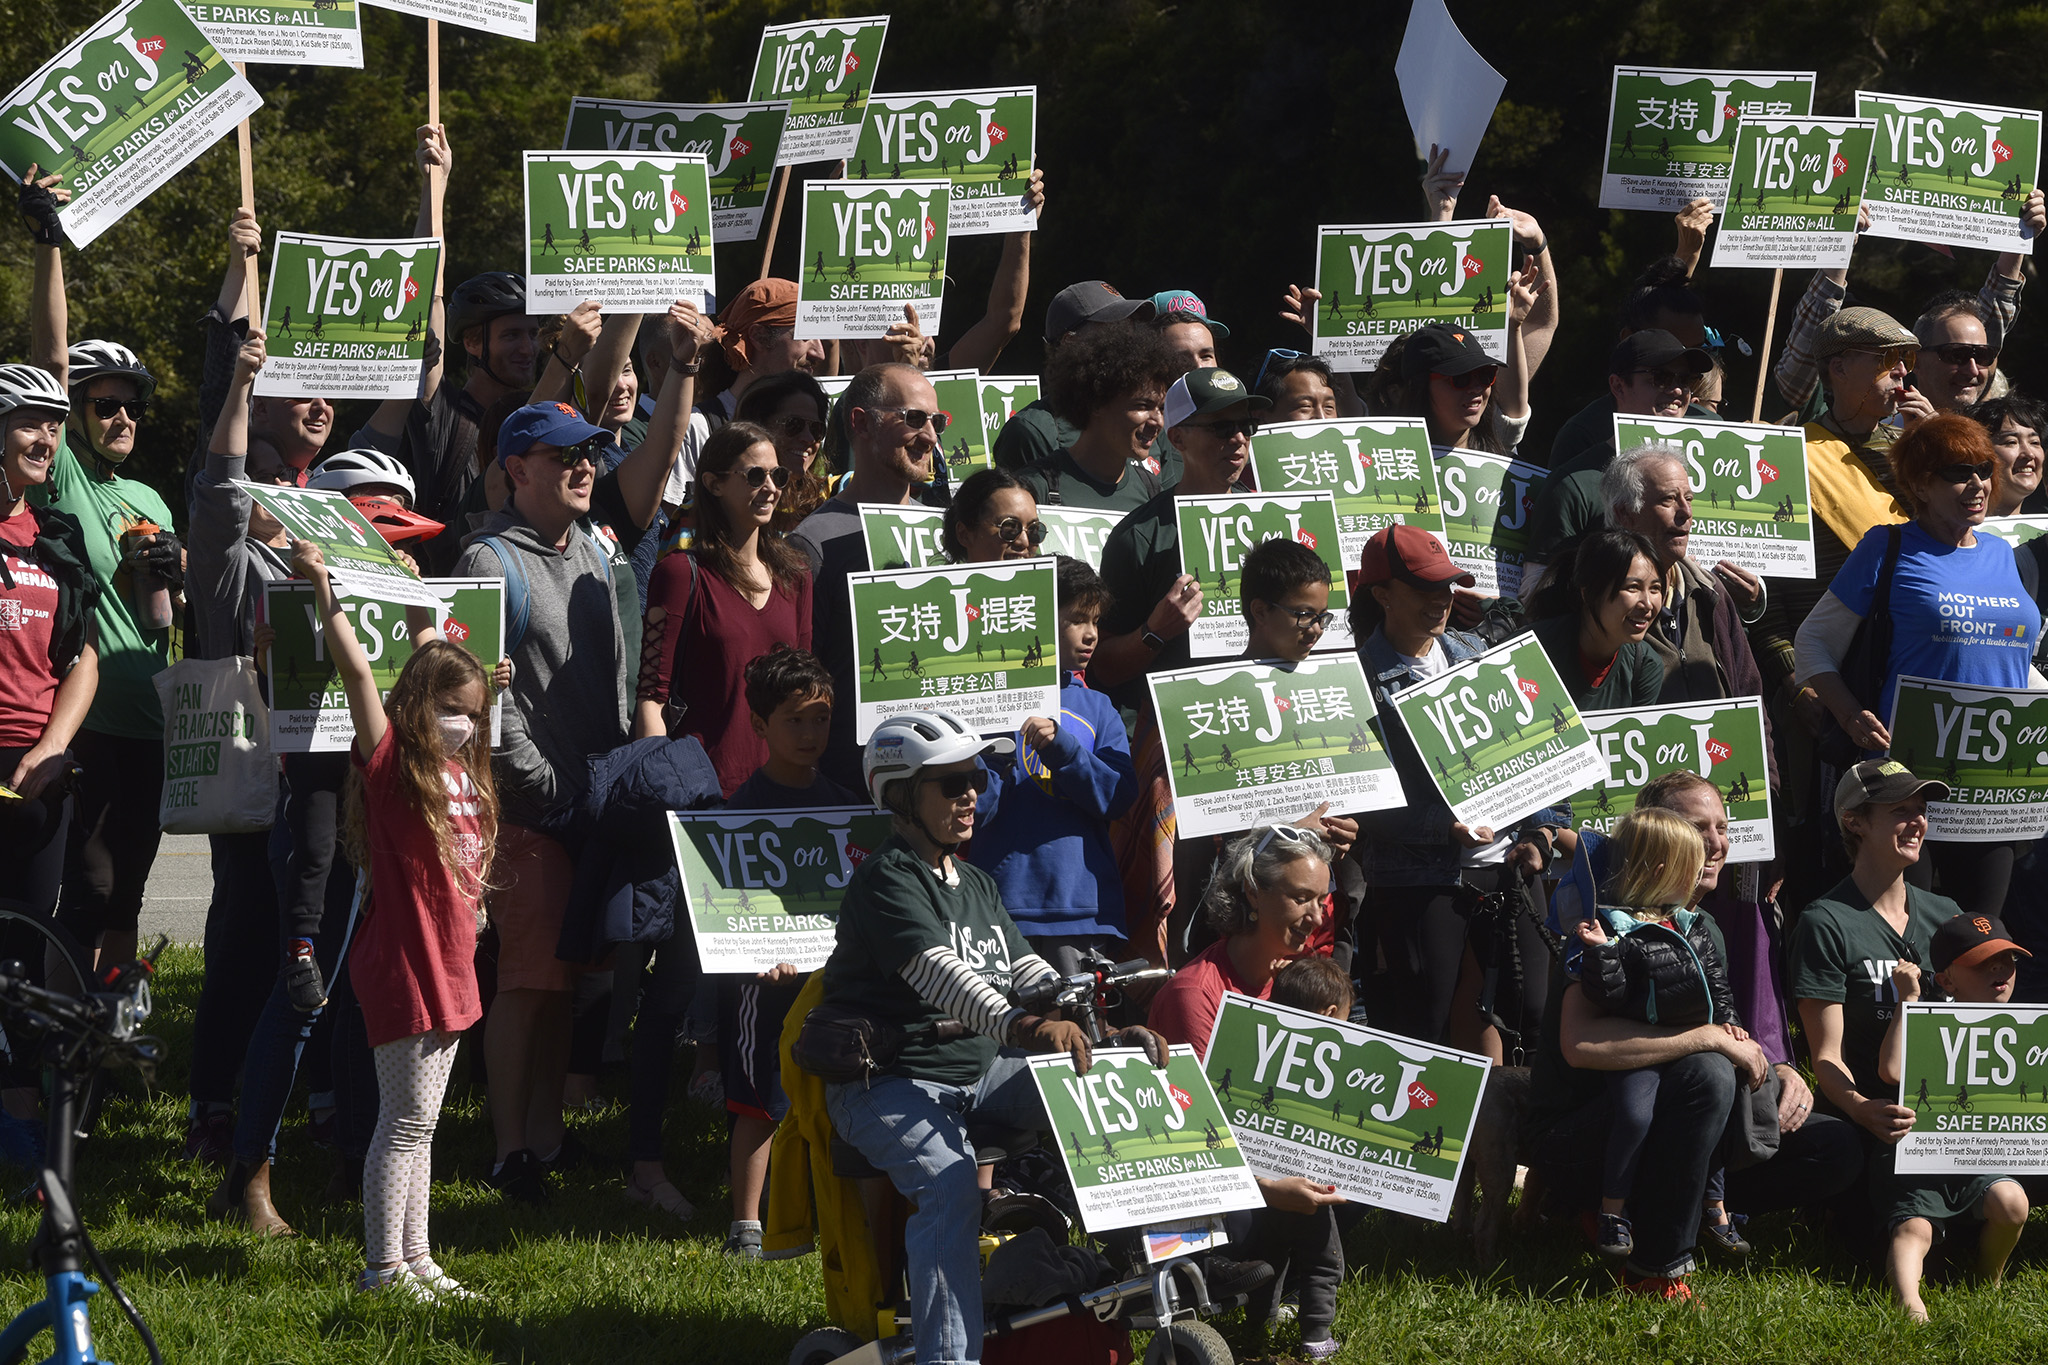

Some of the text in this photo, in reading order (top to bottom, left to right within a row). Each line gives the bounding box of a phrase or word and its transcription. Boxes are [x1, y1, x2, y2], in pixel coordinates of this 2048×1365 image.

[212, 7, 324, 26] PARKS for ALL
[12, 27, 159, 155] YES on J
[772, 39, 856, 95] YES on J
[73, 86, 208, 193] SAFE PARKS for ALL
[786, 114, 817, 130] PARKS
[826, 111, 844, 126] ALL
[874, 109, 996, 163] YES on J
[1635, 91, 1732, 143] 支持 J
[1753, 137, 1843, 194] YES on J
[1884, 113, 2001, 177] YES on J
[1993, 144, 2011, 160] JFK
[558, 173, 675, 234] YES on J
[1741, 215, 1769, 230] SAFE
[1771, 216, 1805, 230] PARKS
[1816, 216, 1835, 230] ALL
[1884, 188, 2007, 214] SAFE PARKS for ALL
[832, 200, 930, 260] YES on J
[307, 258, 414, 321] YES on J
[564, 257, 693, 273] SAFE PARKS for ALL
[1349, 241, 1471, 296] YES on J
[1278, 439, 1421, 494] 支持 J 提案
[1713, 458, 1742, 477] on
[1737, 444, 1764, 500] J
[1690, 520, 1782, 538] PARKS for ALL
[878, 588, 1037, 652] 支持 J 提案
[1938, 592, 2020, 608] MOTHERS
[1939, 604, 1974, 618] OUT
[1941, 620, 1996, 635] FRONT
[176, 683, 202, 709] SAN
[920, 671, 1007, 696] 共享安全公園
[1521, 682, 1538, 694] JFK
[171, 711, 255, 739] FRANCISCO
[1182, 681, 1355, 743] 支持 J 提案
[1422, 664, 1534, 755] YES on J
[1933, 702, 2047, 763] YES on
[169, 745, 216, 773] STARTS
[1235, 757, 1336, 787] 共享安全公園
[1461, 772, 1493, 797] SAFE
[1495, 751, 1536, 782] PARKS
[1545, 737, 1570, 758] ALL
[167, 781, 198, 808] HERE
[1973, 787, 2026, 803] PARKS
[706, 828, 852, 888] YES on J
[727, 914, 832, 932] SAFE PARKS
[1253, 1023, 1426, 1122] YES on J
[1940, 1026, 2017, 1086] YES
[1062, 1069, 1185, 1136] YES on J
[1409, 1087, 1433, 1107] JFK
[1233, 1109, 1417, 1171] SAFE PARKS for ALL
[1936, 1115, 2046, 1132] SAFE PARKS
[1098, 1152, 1222, 1184] SAFE PARKS for ALL
[1237, 1132, 1253, 1142] Save
[1252, 1136, 1268, 1147] John
[1273, 1142, 1300, 1157] Kennedy
[1300, 1149, 1335, 1167] Promenade,
[1335, 1159, 1346, 1168] Yes
[1361, 1166, 1370, 1175] No
[1384, 1171, 1416, 1185] Committee
[1415, 1178, 1433, 1191] major
[1260, 1149, 1278, 1160] Shear
[1312, 1164, 1326, 1174] Zack
[1327, 1168, 1346, 1179] Rosen
[1380, 1181, 1391, 1190] Kid
[1391, 1183, 1405, 1193] Safe
[1405, 1186, 1414, 1195] SF
[1348, 1184, 1384, 1201] sfethics.org.
